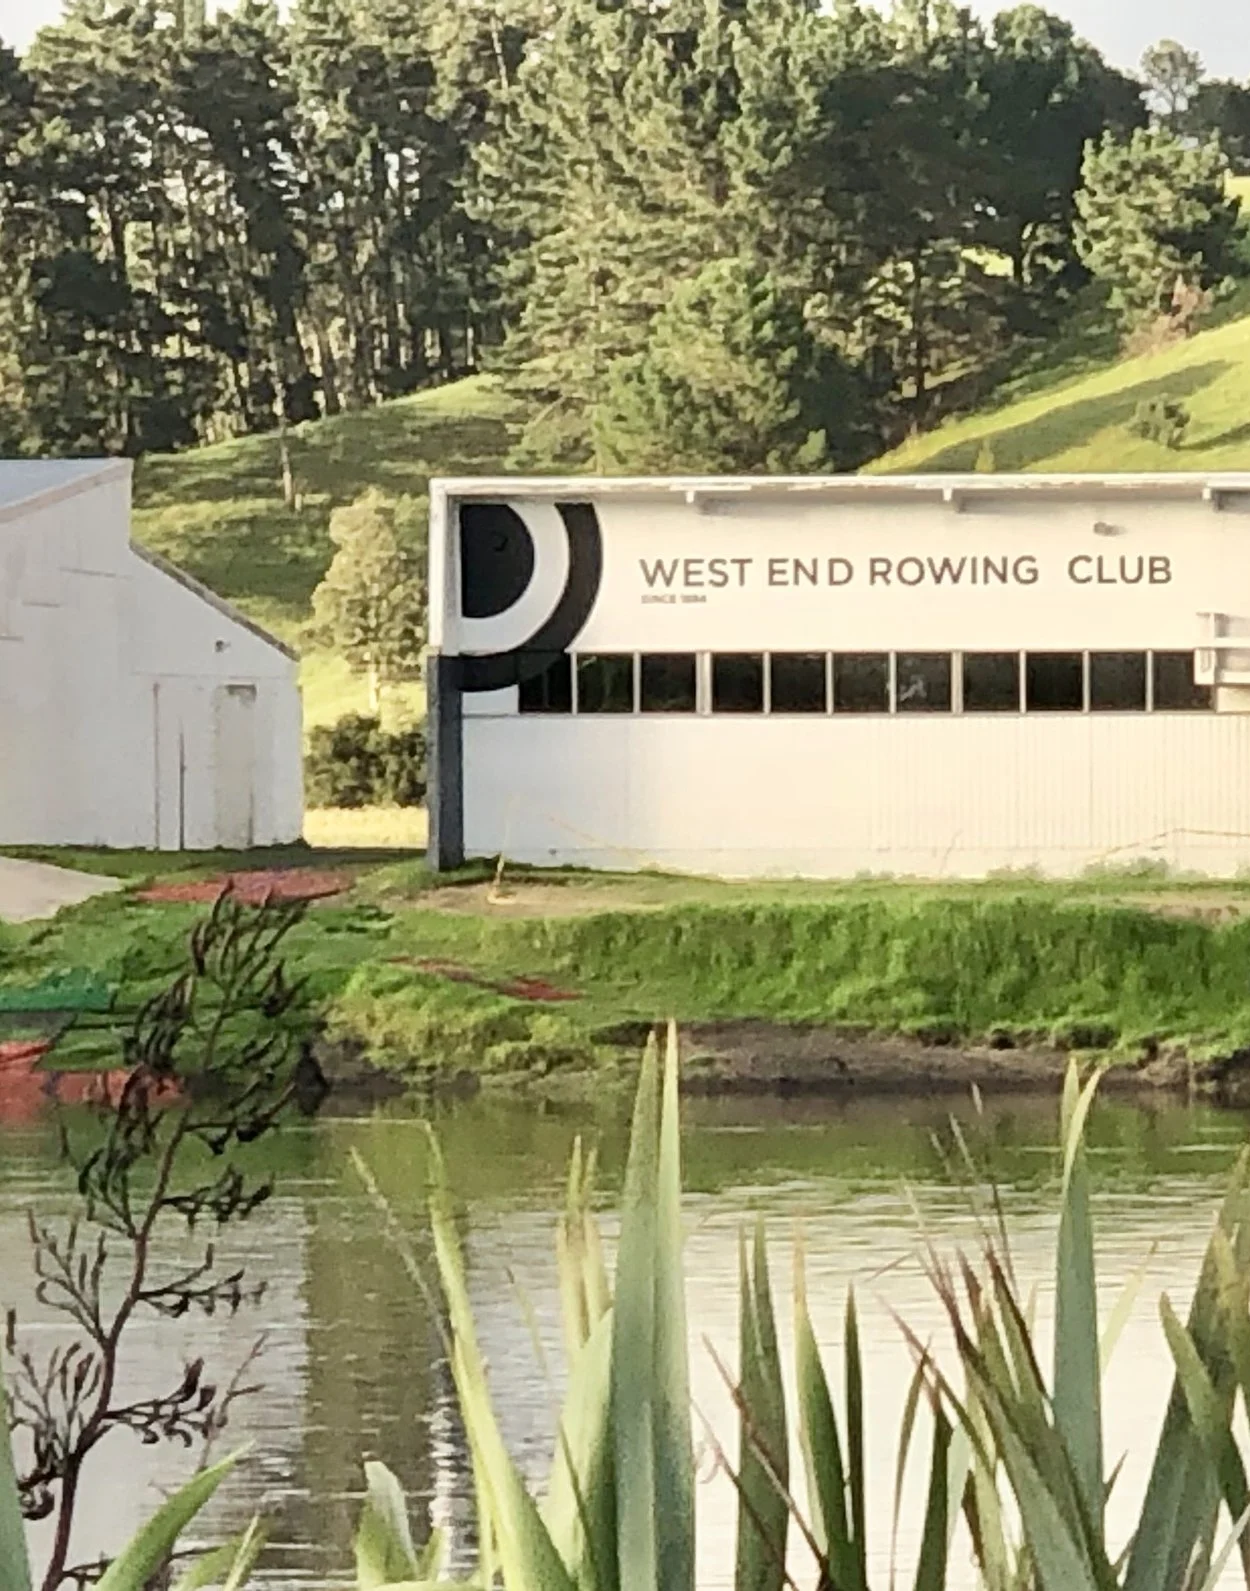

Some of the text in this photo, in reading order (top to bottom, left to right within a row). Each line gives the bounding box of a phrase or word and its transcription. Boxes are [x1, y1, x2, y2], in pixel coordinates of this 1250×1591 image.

[639, 555, 1172, 588] WEST END ROWING CLUB
